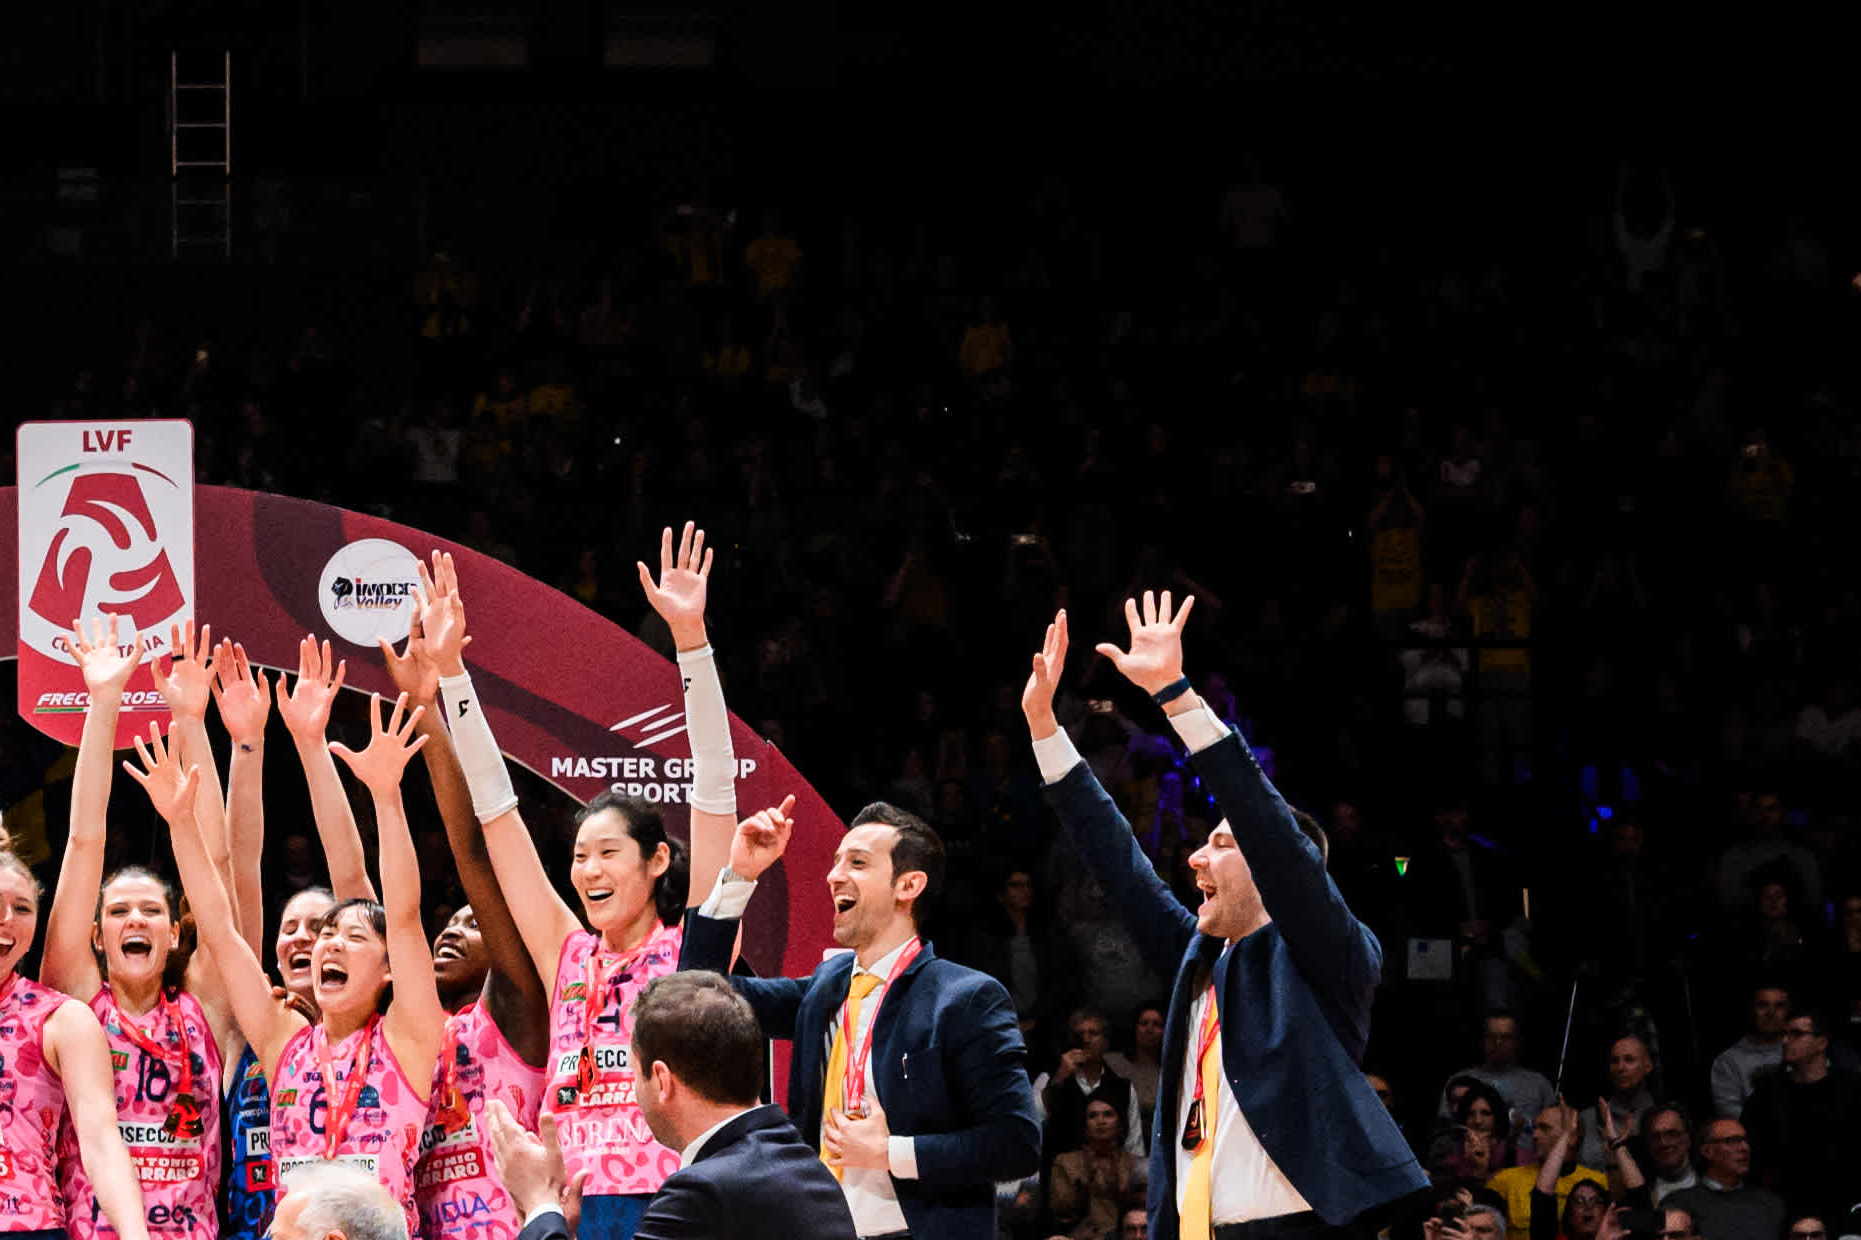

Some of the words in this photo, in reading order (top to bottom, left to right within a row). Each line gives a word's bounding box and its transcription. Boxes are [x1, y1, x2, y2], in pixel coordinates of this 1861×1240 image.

[82, 430, 133, 453] LVF
[117, 635, 164, 658] TAIA
[551, 757, 656, 778] MASTER
[663, 758, 757, 779] GRP
[610, 783, 694, 804] SPORT
[559, 1049, 628, 1073] PRECC
[135, 1053, 171, 1103] 18
[579, 1091, 638, 1107] CARRA
[118, 1125, 176, 1144] SECCO
[136, 1157, 198, 1168] NTONIO
